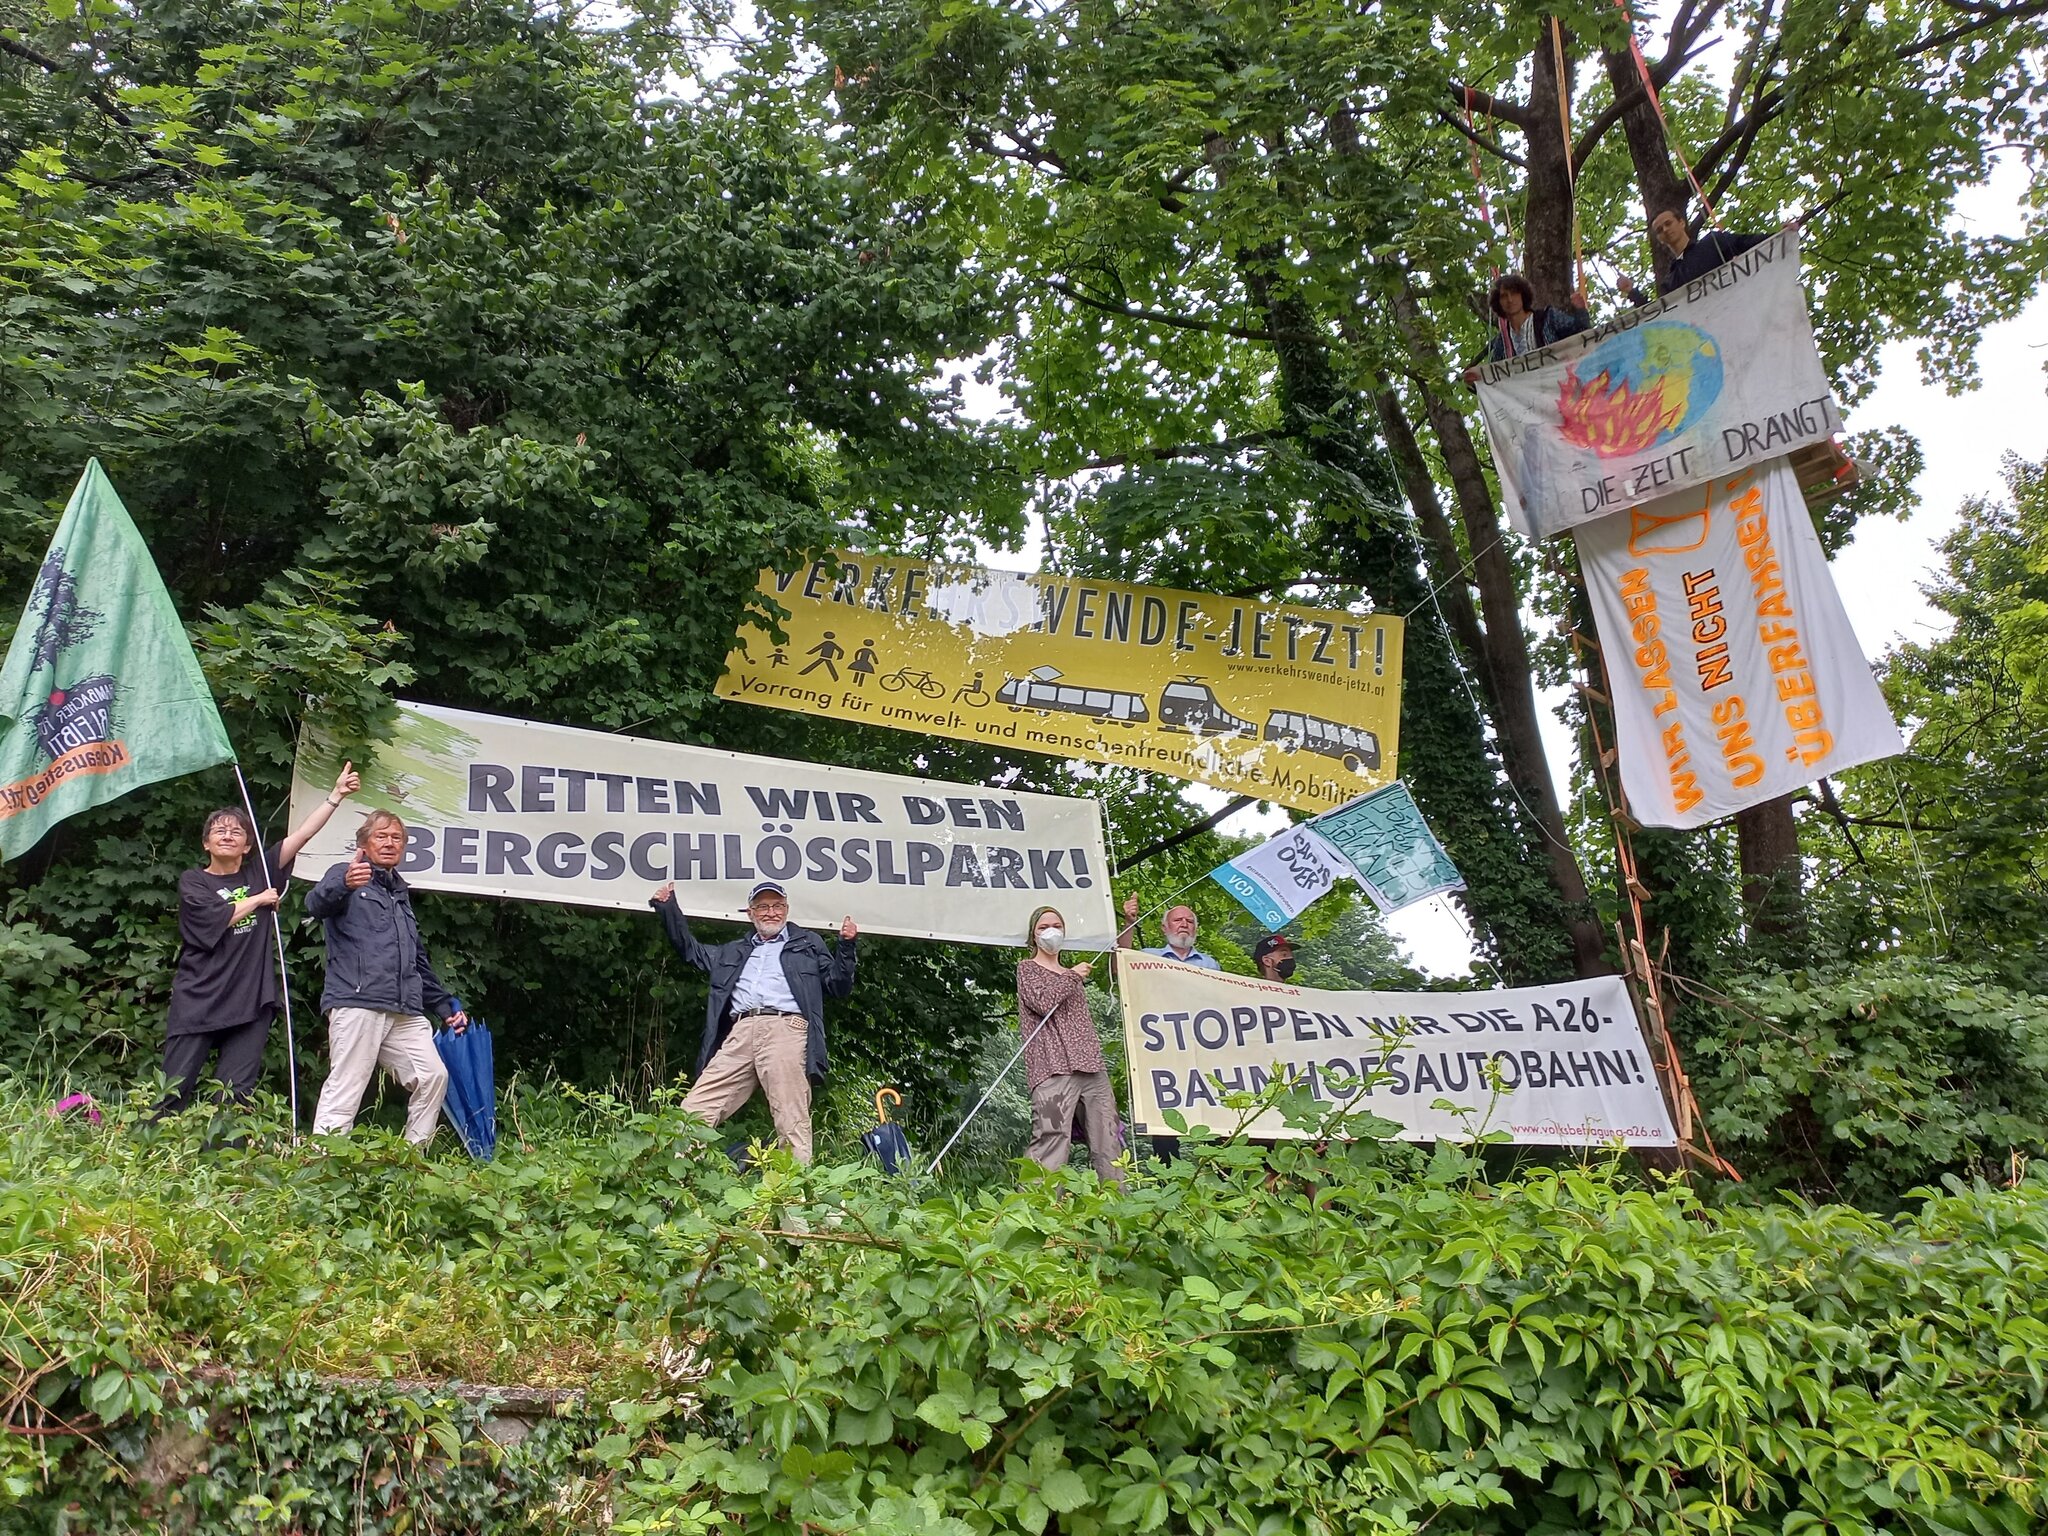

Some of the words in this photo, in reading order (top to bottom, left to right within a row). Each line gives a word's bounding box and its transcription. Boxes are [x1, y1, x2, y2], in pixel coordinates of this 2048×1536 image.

[1480, 348, 1559, 387] UNSER
[1686, 234, 1790, 305] BRENNT
[1580, 476, 1622, 514] DIE
[1630, 446, 1696, 497] ZEIT
[1722, 395, 1832, 463] DRÄNGT
[1618, 566, 1678, 720] LASSEN
[1682, 568, 1733, 691] NICHT
[1227, 662, 1386, 698] www.verkehrswende-jetzt.at
[740, 675, 832, 709] Vorrang
[841, 692, 874, 712] für
[881, 706, 967, 729] umwelt-
[975, 718, 1017, 738] und
[1025, 729, 1262, 785] menschenfreundliche
[1271, 767, 1361, 803] Mobilitä
[1660, 720, 1704, 815] WIR
[1711, 694, 1766, 789] UNS
[468, 763, 722, 816] RETTEN
[744, 785, 883, 824] WIR
[901, 795, 1026, 832] DEN
[398, 822, 1093, 889] BERGSCHLÖSSLPARK!
[1227, 873, 1255, 899] VCD
[1276, 846, 1320, 891] OVER
[1129, 961, 1300, 997] www.verkehrswende-jetzt.at
[1140, 1005, 1353, 1052] STOPPEN
[1356, 1015, 1450, 1038] WIR
[1448, 1008, 1524, 1033] DIE
[1531, 996, 1613, 1034] A26-
[1151, 1048, 1646, 1109] BAHNHOFSAUTOBAHN!
